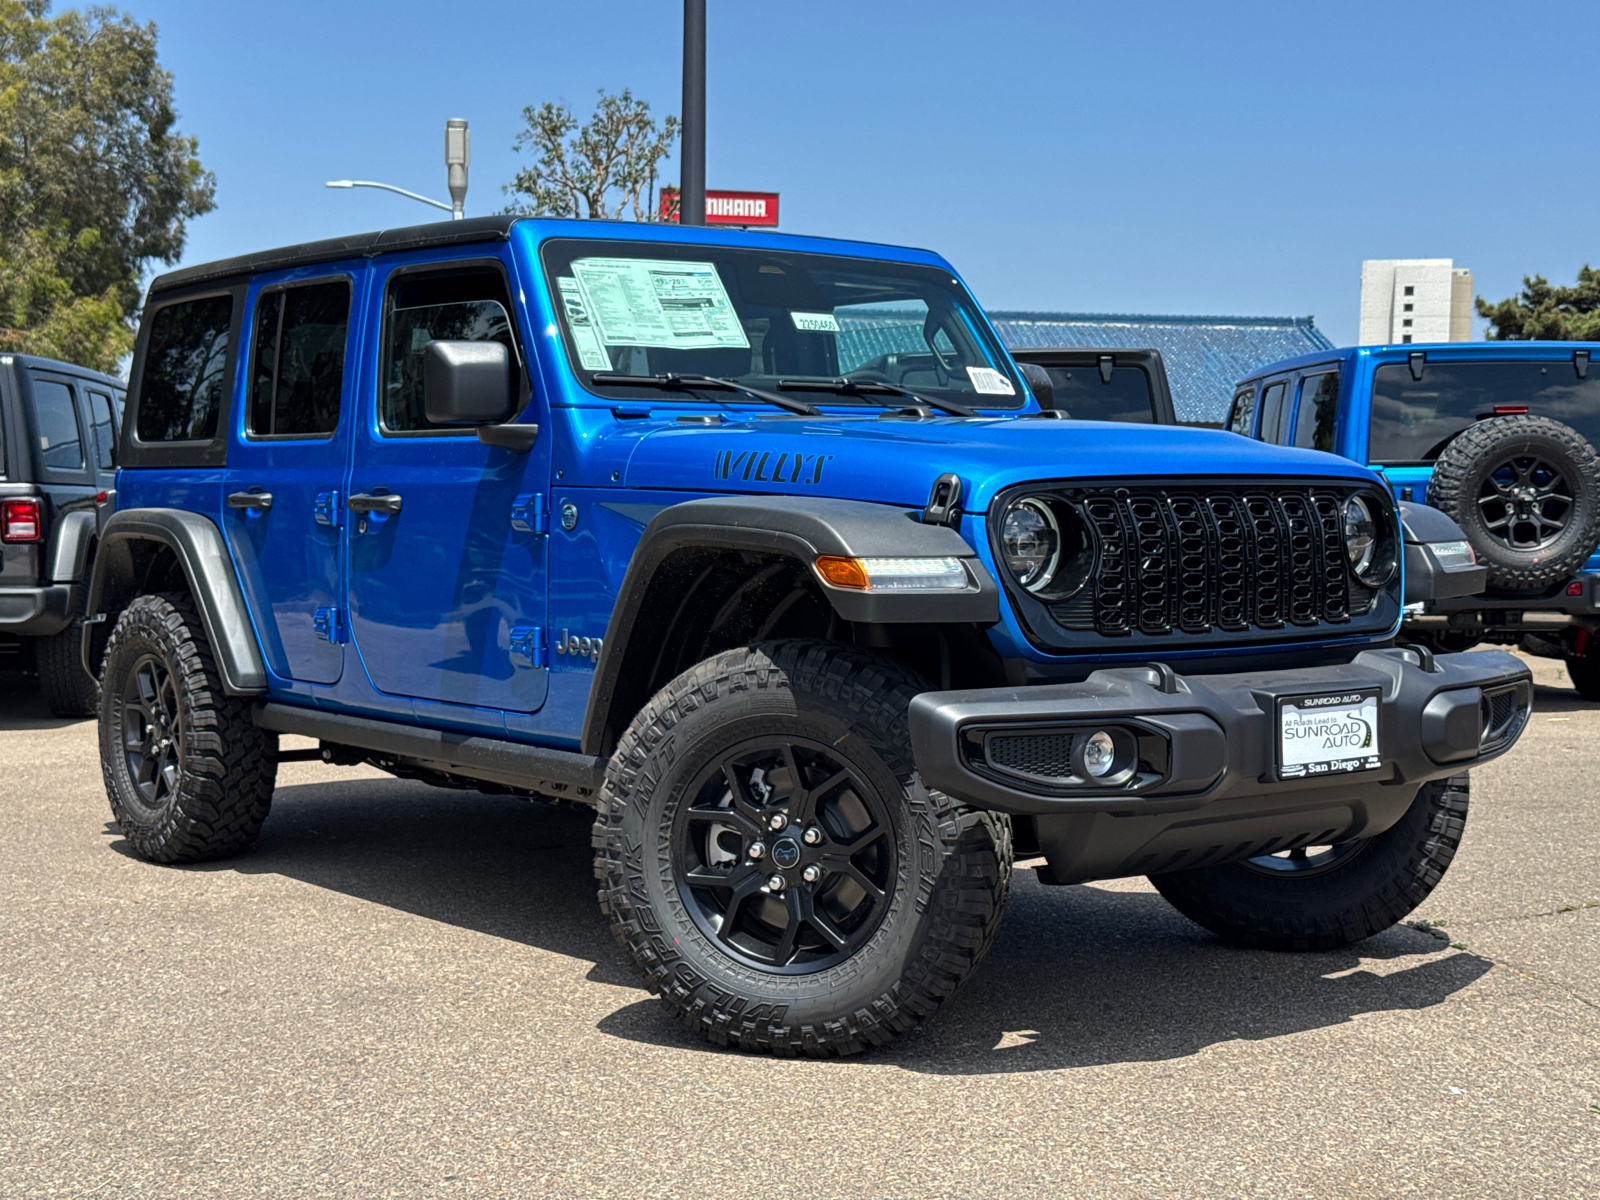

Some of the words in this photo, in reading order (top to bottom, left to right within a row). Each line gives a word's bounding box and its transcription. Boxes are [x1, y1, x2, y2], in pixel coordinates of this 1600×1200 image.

[705, 197, 767, 217] NIHANA
[714, 450, 834, 484] WILLYS
[555, 628, 603, 663] Jeep
[1304, 697, 1341, 706] SUNROAD
[1342, 695, 1360, 703] AUTO
[1293, 718, 1313, 726] Roads
[1314, 717, 1330, 725] Lead
[1331, 716, 1337, 724] to
[1284, 722, 1361, 740] SUNROAD
[1322, 733, 1361, 749] AUTO
[1308, 763, 1328, 773] San
[1330, 760, 1360, 771] Diego
[633, 735, 676, 819] M/T
[625, 834, 790, 1022] WILDPEAK
